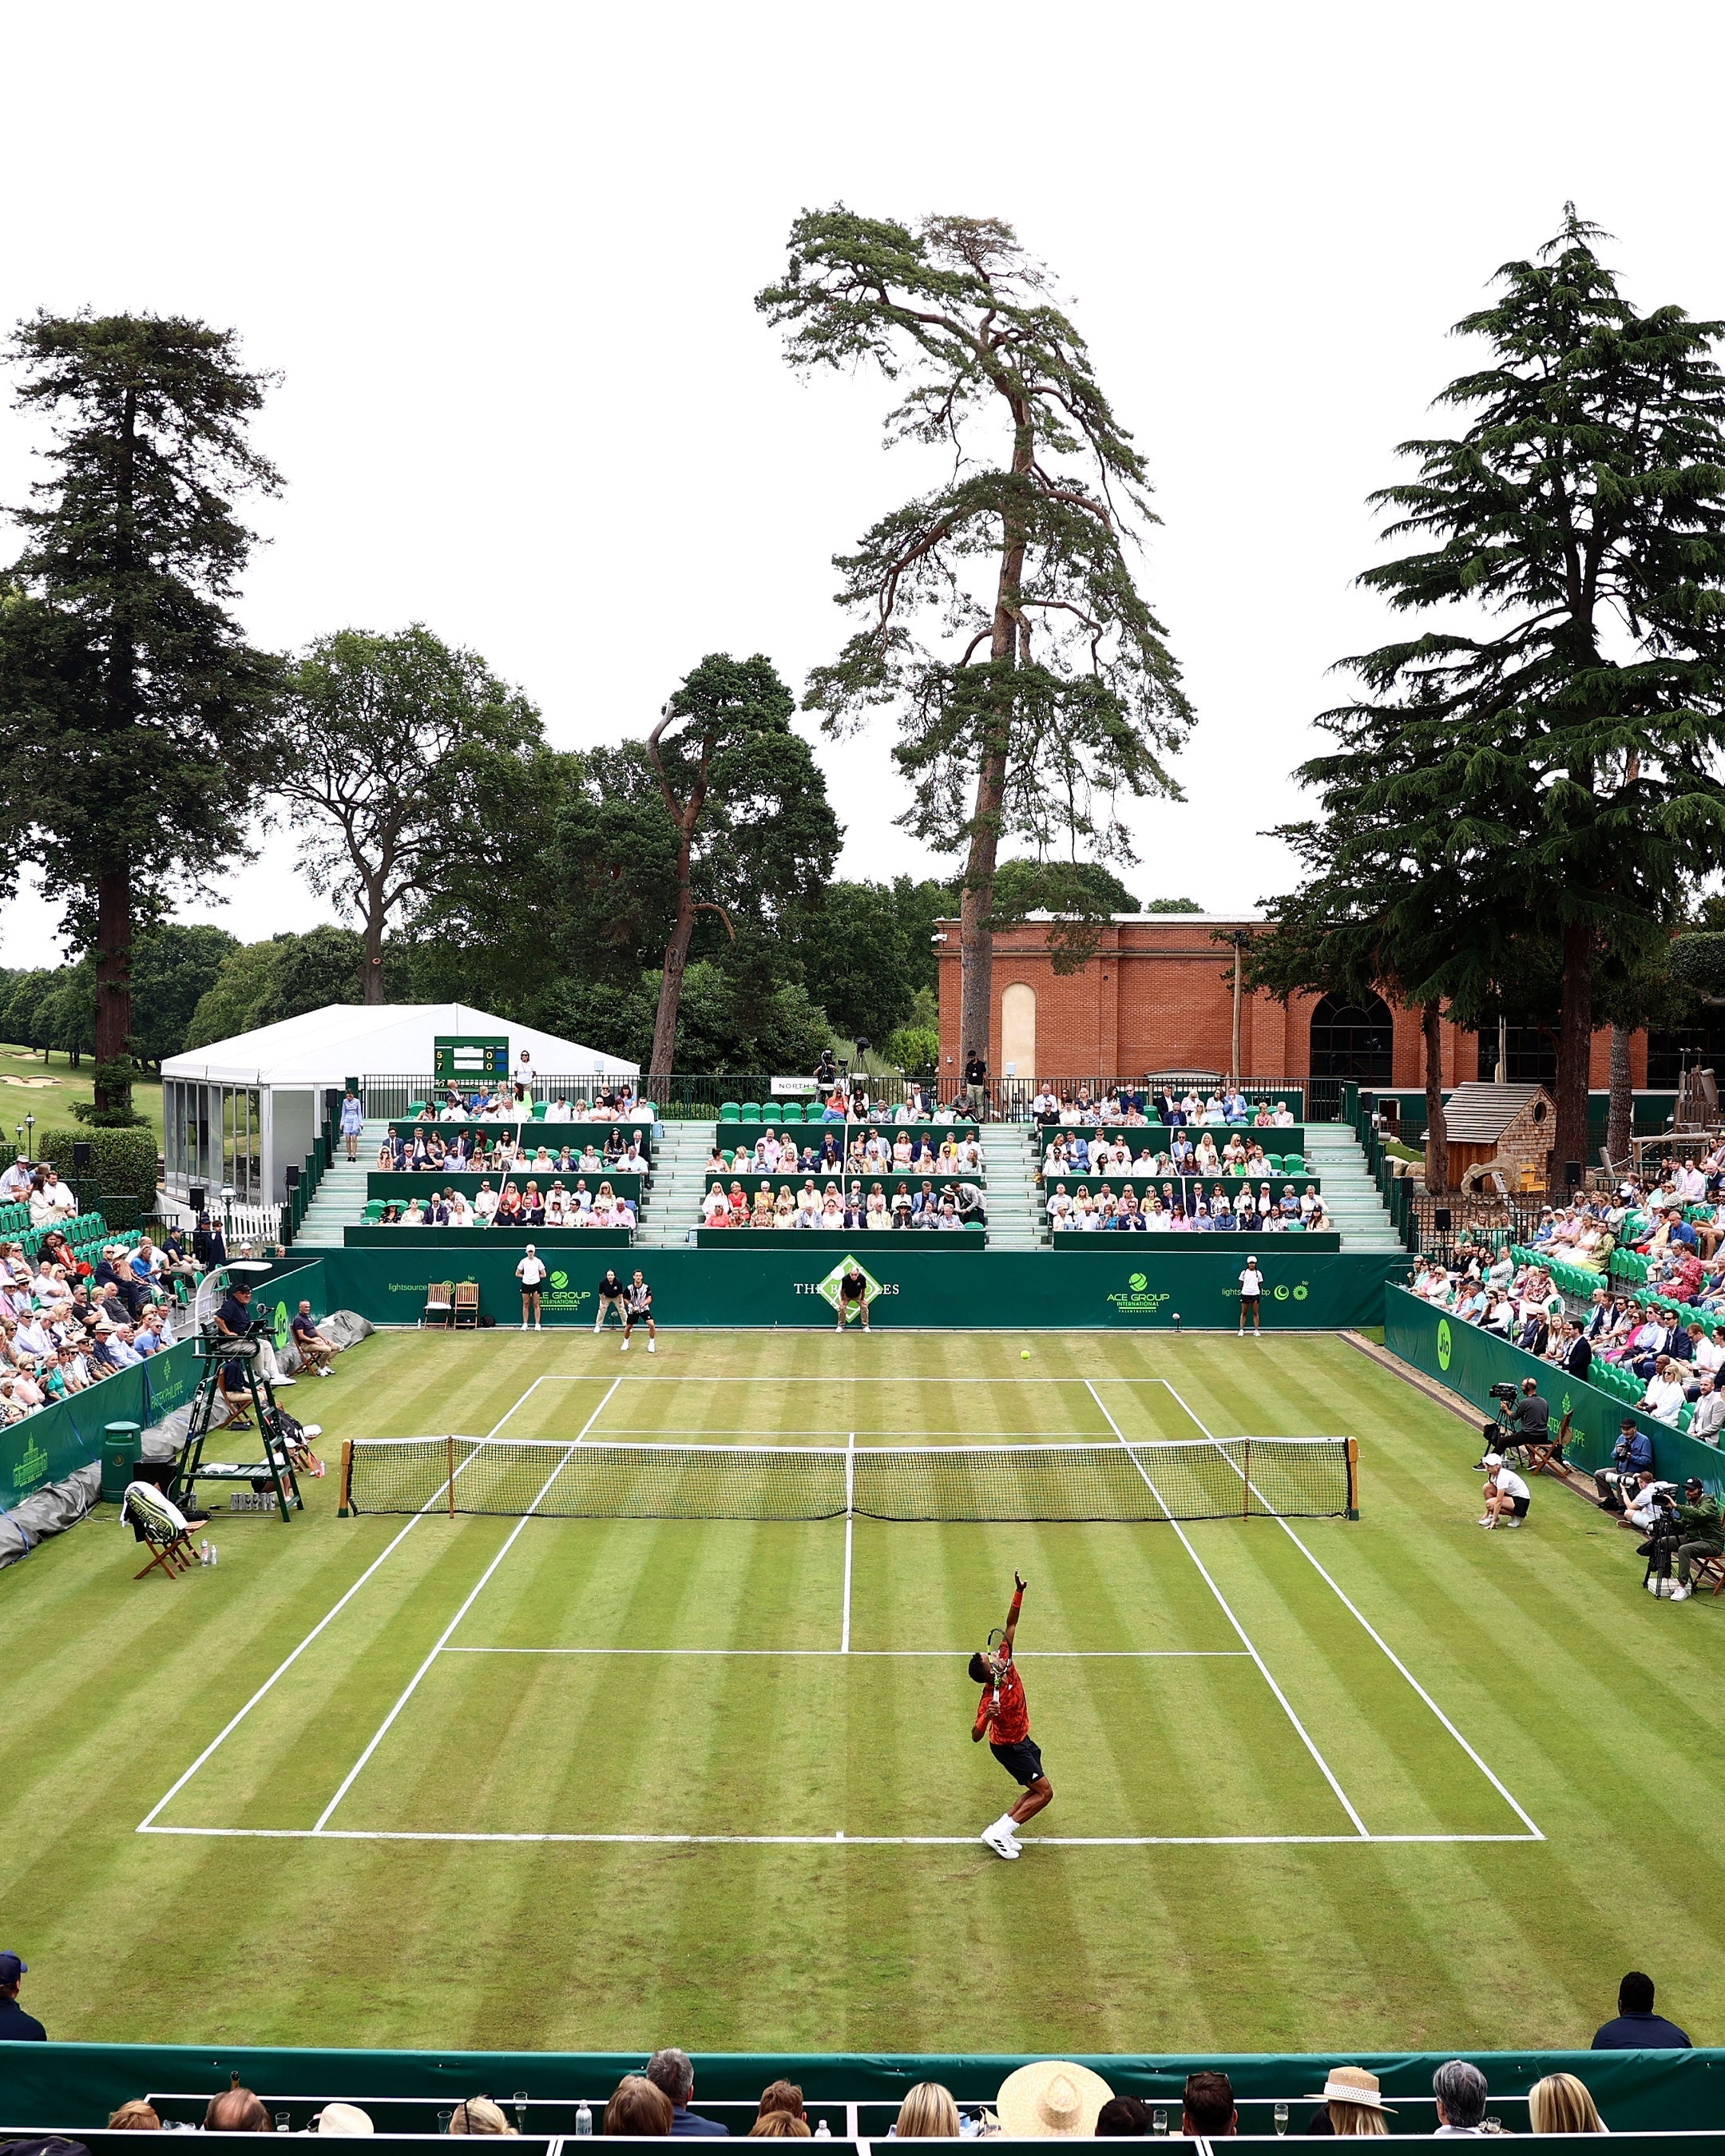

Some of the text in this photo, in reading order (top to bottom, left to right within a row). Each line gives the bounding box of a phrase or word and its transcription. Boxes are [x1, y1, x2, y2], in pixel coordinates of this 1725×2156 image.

[388, 1283, 428, 1292] lightsource
[1222, 1288, 1242, 1297] lights
[1439, 1332, 1449, 1356] Jio
[1547, 1417, 1560, 1433] ATEK
